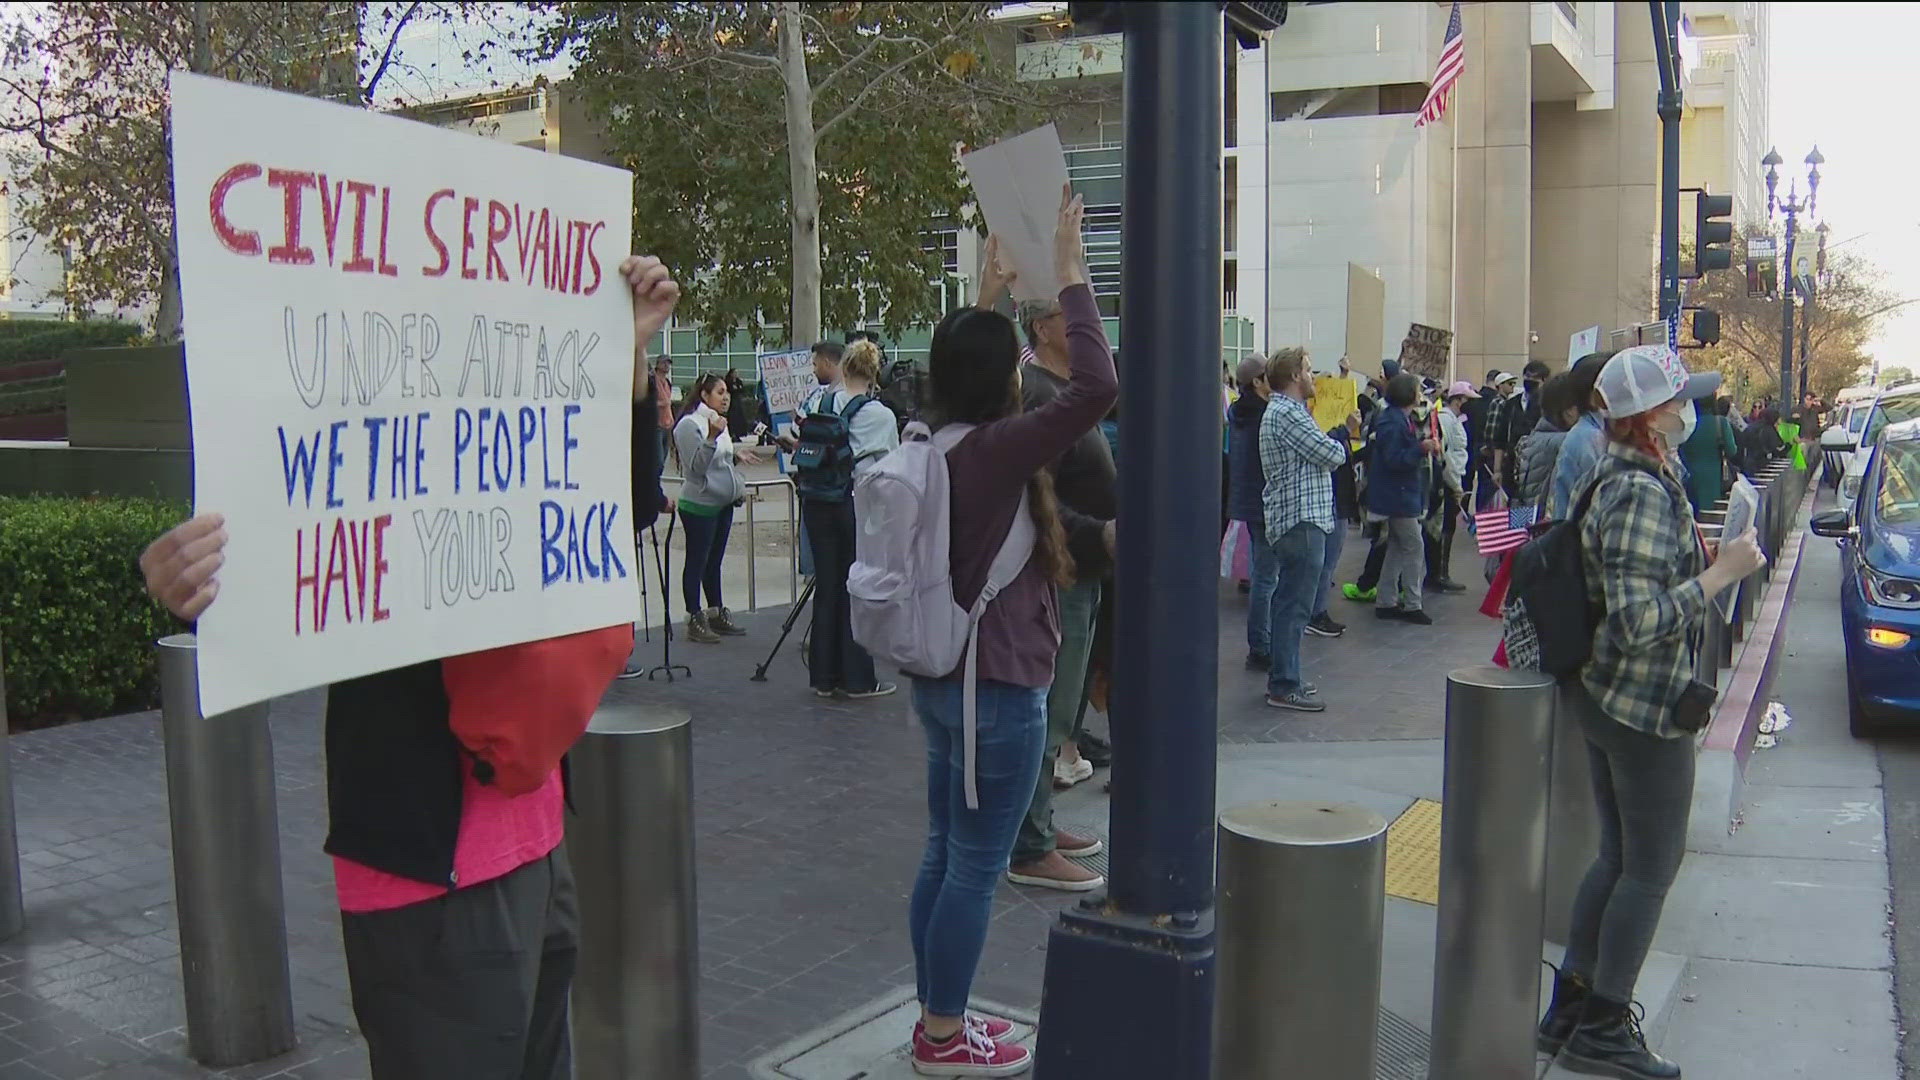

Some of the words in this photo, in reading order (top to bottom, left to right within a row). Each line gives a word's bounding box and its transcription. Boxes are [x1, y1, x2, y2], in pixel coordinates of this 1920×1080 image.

[209, 162, 398, 277] CIVIL
[422, 188, 606, 296] SERVANTS
[284, 305, 441, 409] UNDER
[457, 314, 600, 401] ATTACK
[763, 356, 788, 370] LEVIN
[764, 373, 814, 390] SUPPORTING
[277, 418, 347, 510] WE
[363, 411, 431, 502] THE
[454, 405, 580, 496] PEOPLE
[295, 514, 392, 636] HAVE
[413, 507, 515, 610] YOUR
[540, 501, 627, 591] BACK
